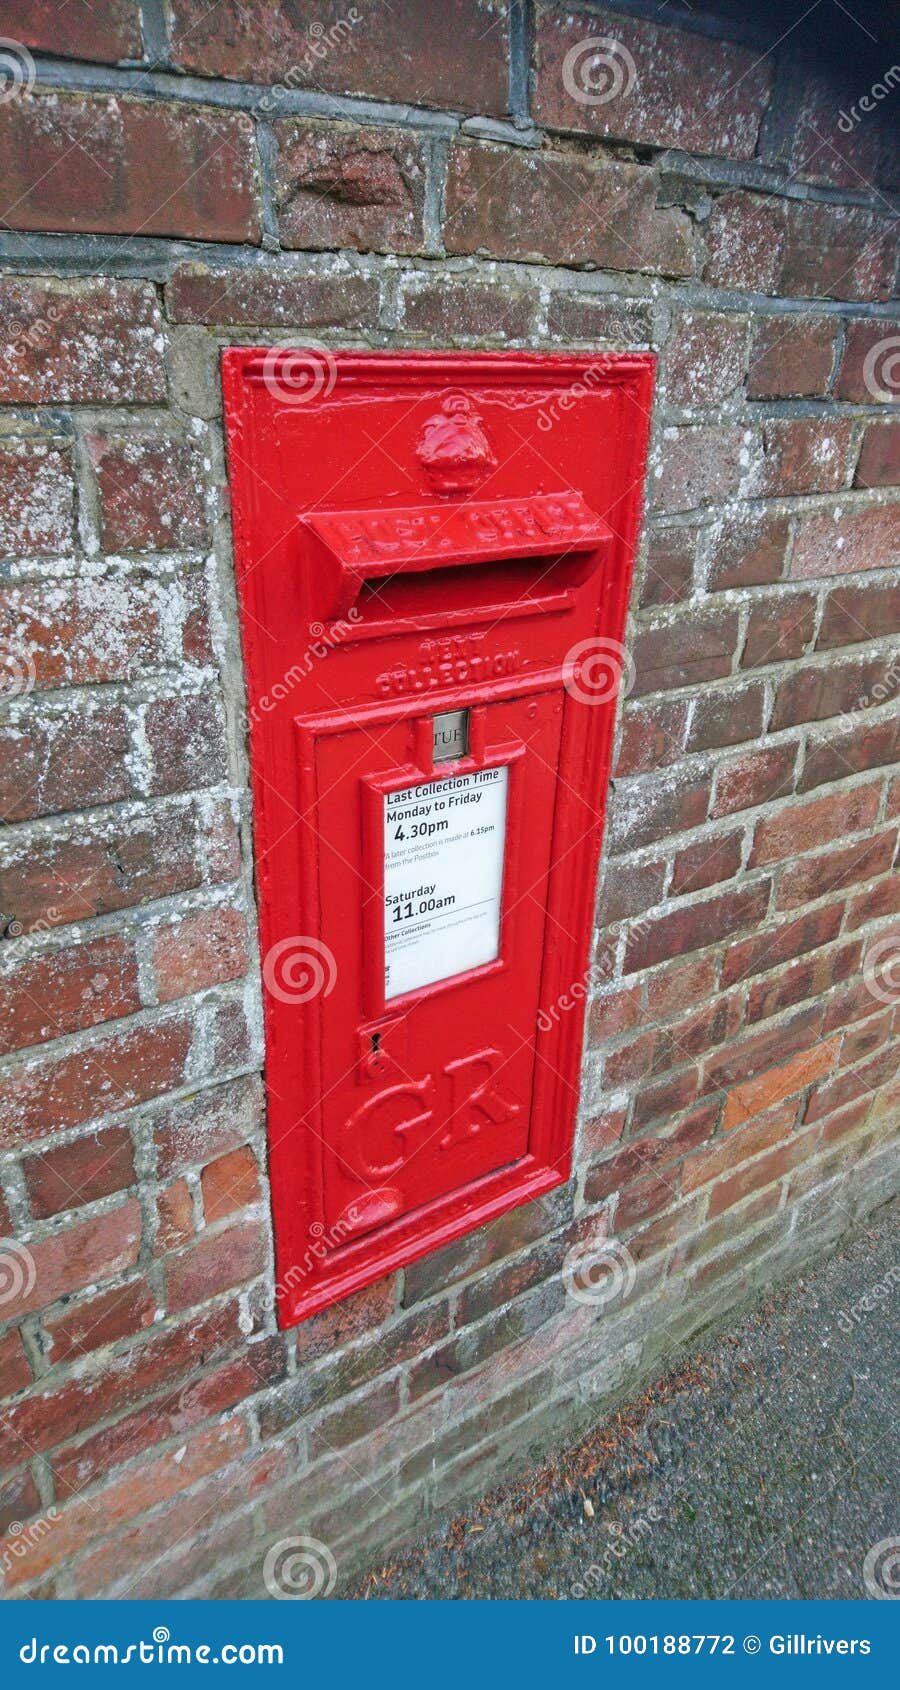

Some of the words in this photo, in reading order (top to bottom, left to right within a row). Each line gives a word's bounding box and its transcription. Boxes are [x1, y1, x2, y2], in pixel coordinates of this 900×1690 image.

[433, 728, 463, 746] TUE
[387, 790, 412, 805] Last
[415, 777, 470, 798] Collection
[472, 770, 499, 784] Time
[386, 804, 432, 823] Monday
[434, 801, 445, 811] to
[448, 792, 482, 808] Friday
[393, 819, 449, 842] 4.30pm
[407, 839, 438, 855] collection
[470, 824, 495, 837] 6.15pm
[385, 884, 436, 907] Saturday
[392, 895, 456, 923] 11.00am
[401, 922, 432, 936] Collections
[338, 1047, 521, 1182] GR
